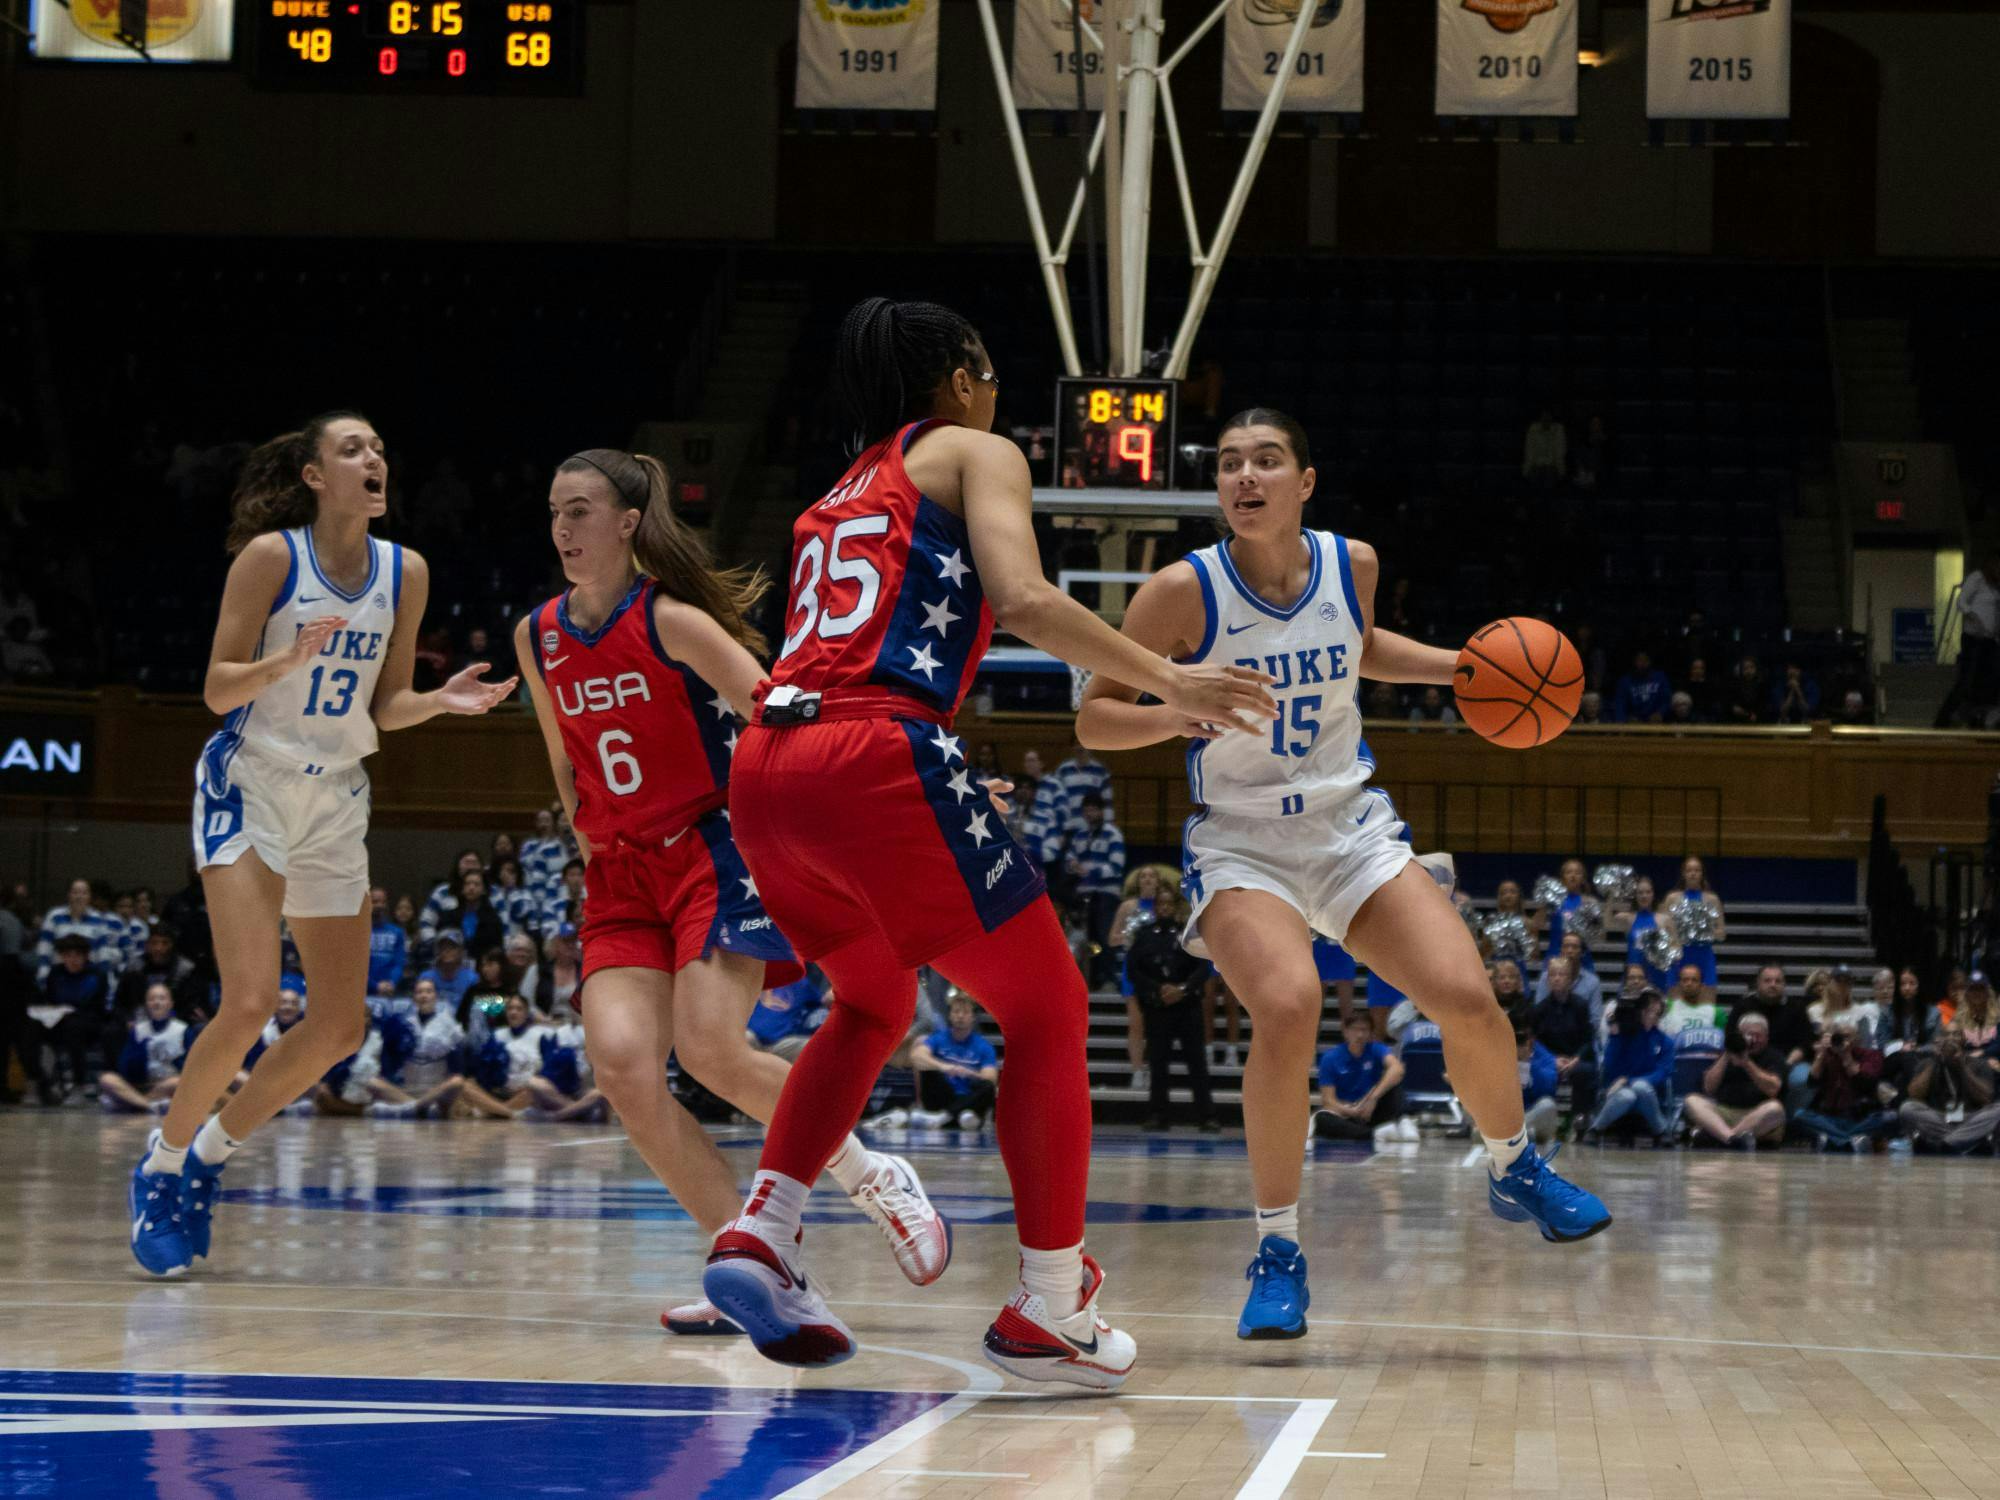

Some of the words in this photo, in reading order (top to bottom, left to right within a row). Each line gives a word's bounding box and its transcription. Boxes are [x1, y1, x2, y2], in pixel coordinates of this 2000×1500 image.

[272, 1, 330, 17] DUKE
[389, 2, 463, 35] 8:15
[507, 5, 551, 21] USA
[288, 29, 332, 62] 48
[379, 48, 397, 75] 0
[506, 33, 551, 67] 68
[839, 48, 897, 72] 1991
[448, 49, 466, 76] 0
[1053, 51, 1104, 74] 199
[1264, 52, 1324, 75] 201
[1479, 55, 1541, 78] 2010
[1689, 58, 1753, 81] 2015
[1090, 389, 1164, 423] 8:14
[1119, 426, 1152, 482] 9
[780, 514, 890, 662] 35
[296, 623, 382, 660] UKE
[303, 665, 359, 717] 13
[556, 671, 651, 717] USA
[1270, 694, 1323, 758] 15
[0, 738, 81, 773] AN
[597, 729, 643, 796] 6
[986, 849, 1013, 890] USA
[740, 916, 771, 932] USA
[1413, 1025, 1441, 1042] DUK
[1685, 1031, 1721, 1049] DUKE
